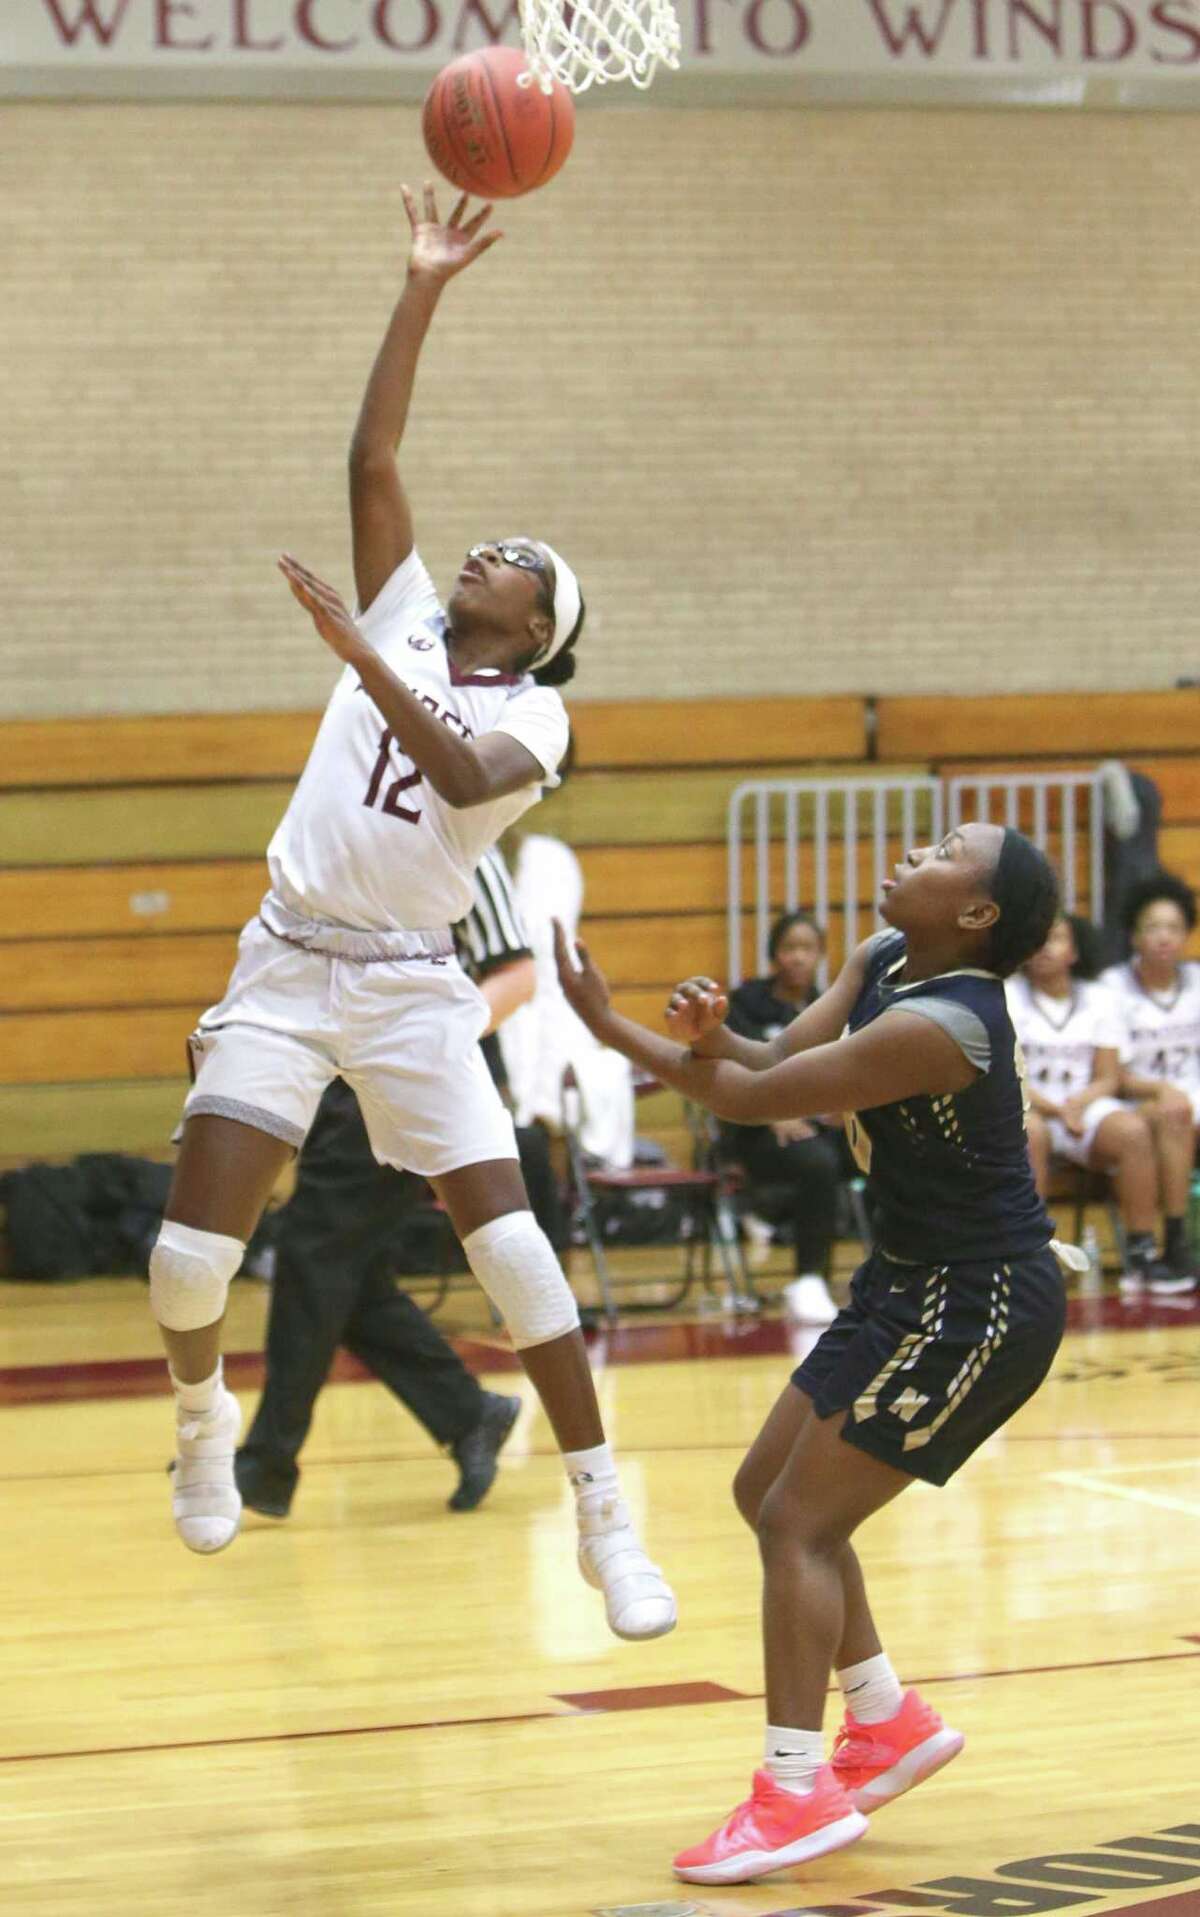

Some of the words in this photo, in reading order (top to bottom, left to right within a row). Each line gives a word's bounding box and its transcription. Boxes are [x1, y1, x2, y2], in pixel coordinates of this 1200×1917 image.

[43, 0, 612, 54] WELCOM
[691, 0, 813, 58] TO
[864, 0, 1200, 64] WINDS
[363, 727, 424, 825] 12
